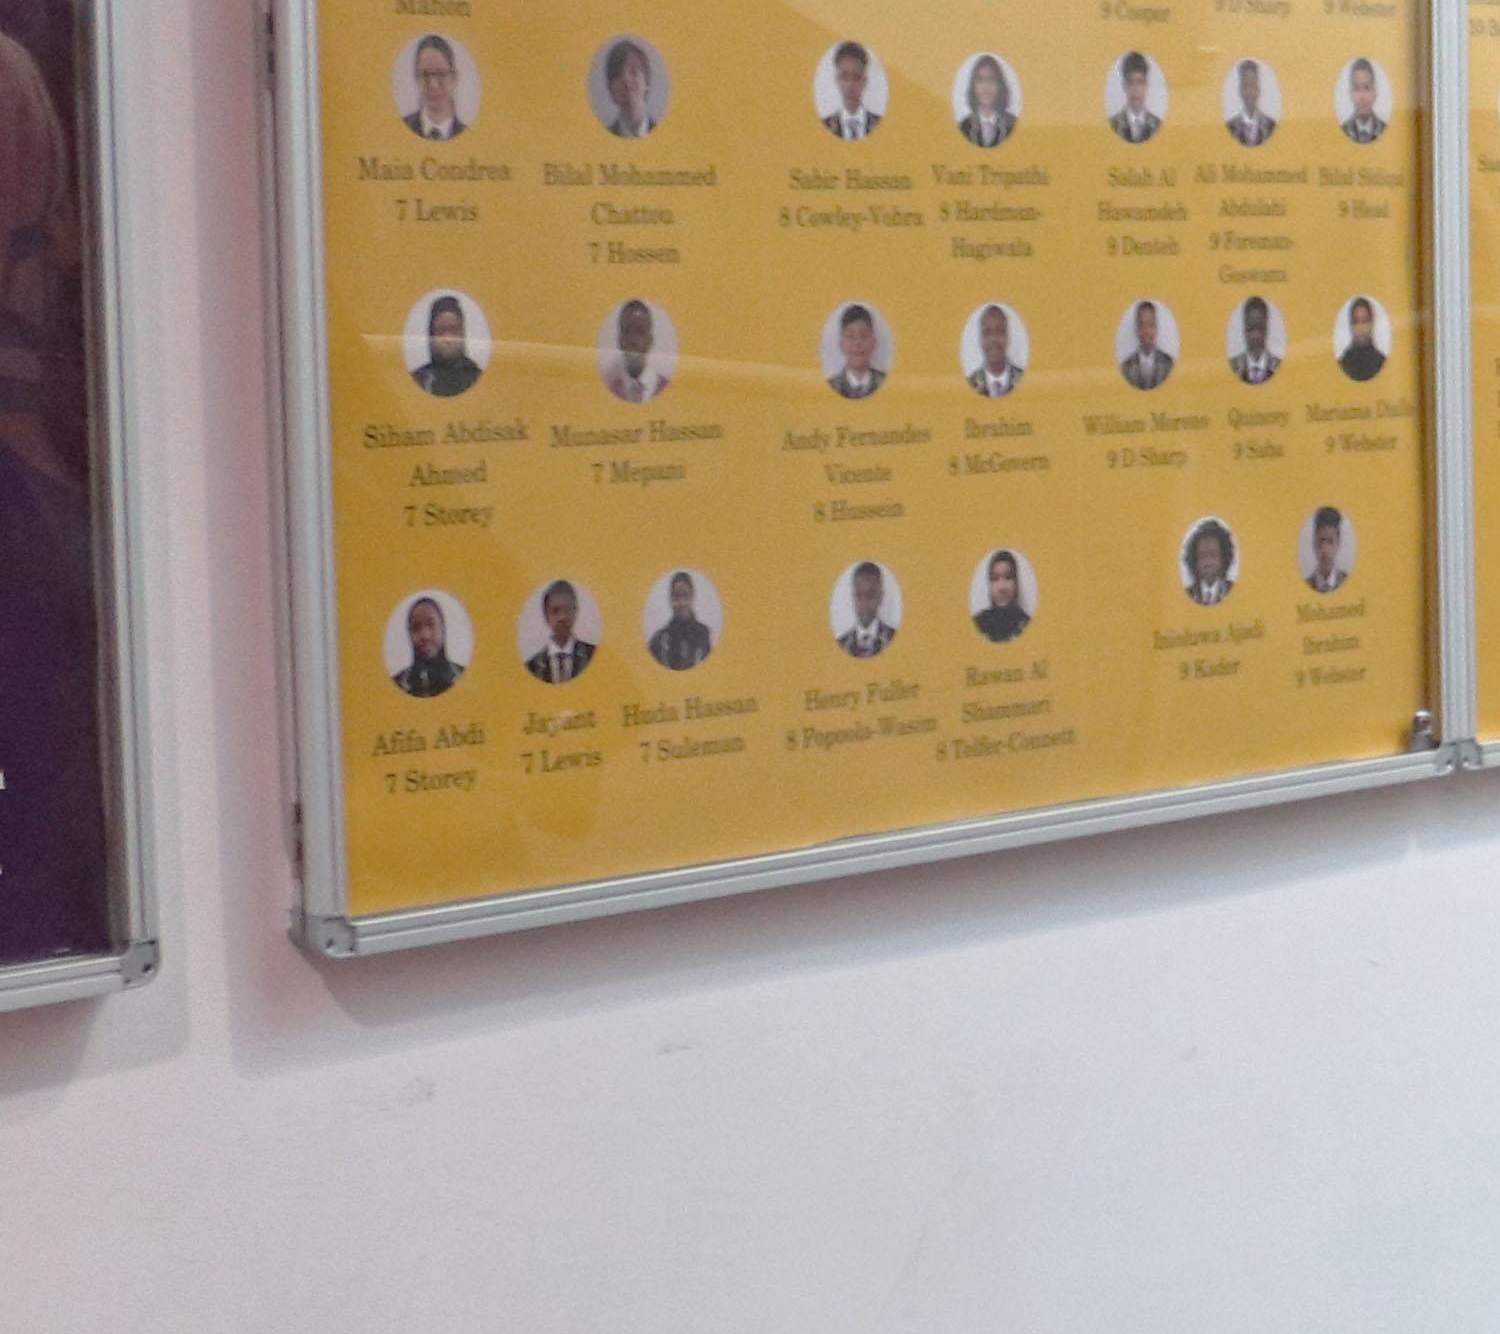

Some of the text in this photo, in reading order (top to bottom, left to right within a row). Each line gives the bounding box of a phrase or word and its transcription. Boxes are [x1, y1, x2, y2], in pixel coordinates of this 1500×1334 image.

[394, 198, 480, 223] 7 Lewis
[587, 241, 600, 264] 7
[409, 459, 488, 488] Ahmed
[591, 462, 604, 485] 7
[403, 503, 494, 530] 7 Storey
[684, 694, 760, 722] Hassan
[432, 721, 486, 750] Abdi
[520, 745, 603, 775] 7 Lewis
[638, 741, 651, 764] 7
[385, 768, 478, 796] 7 Storey
